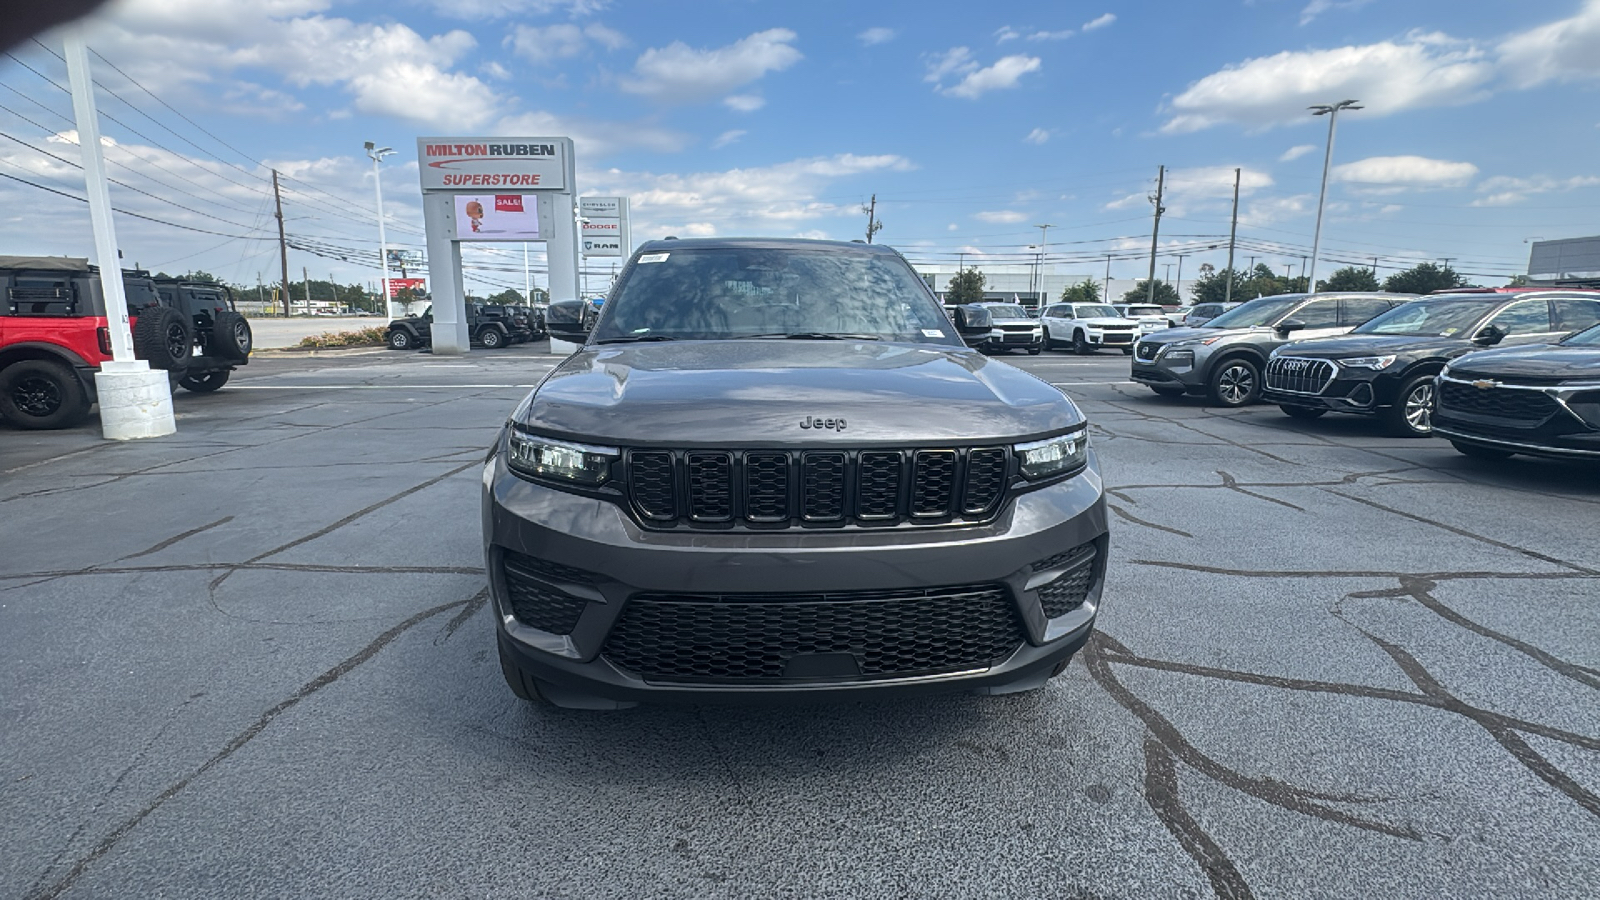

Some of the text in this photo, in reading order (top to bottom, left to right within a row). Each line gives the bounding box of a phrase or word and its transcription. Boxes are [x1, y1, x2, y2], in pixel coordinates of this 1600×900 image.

[426, 144, 555, 156] MILTON RUBEN
[443, 174, 541, 185] SUPERSTORE
[799, 416, 847, 432] Jeep
